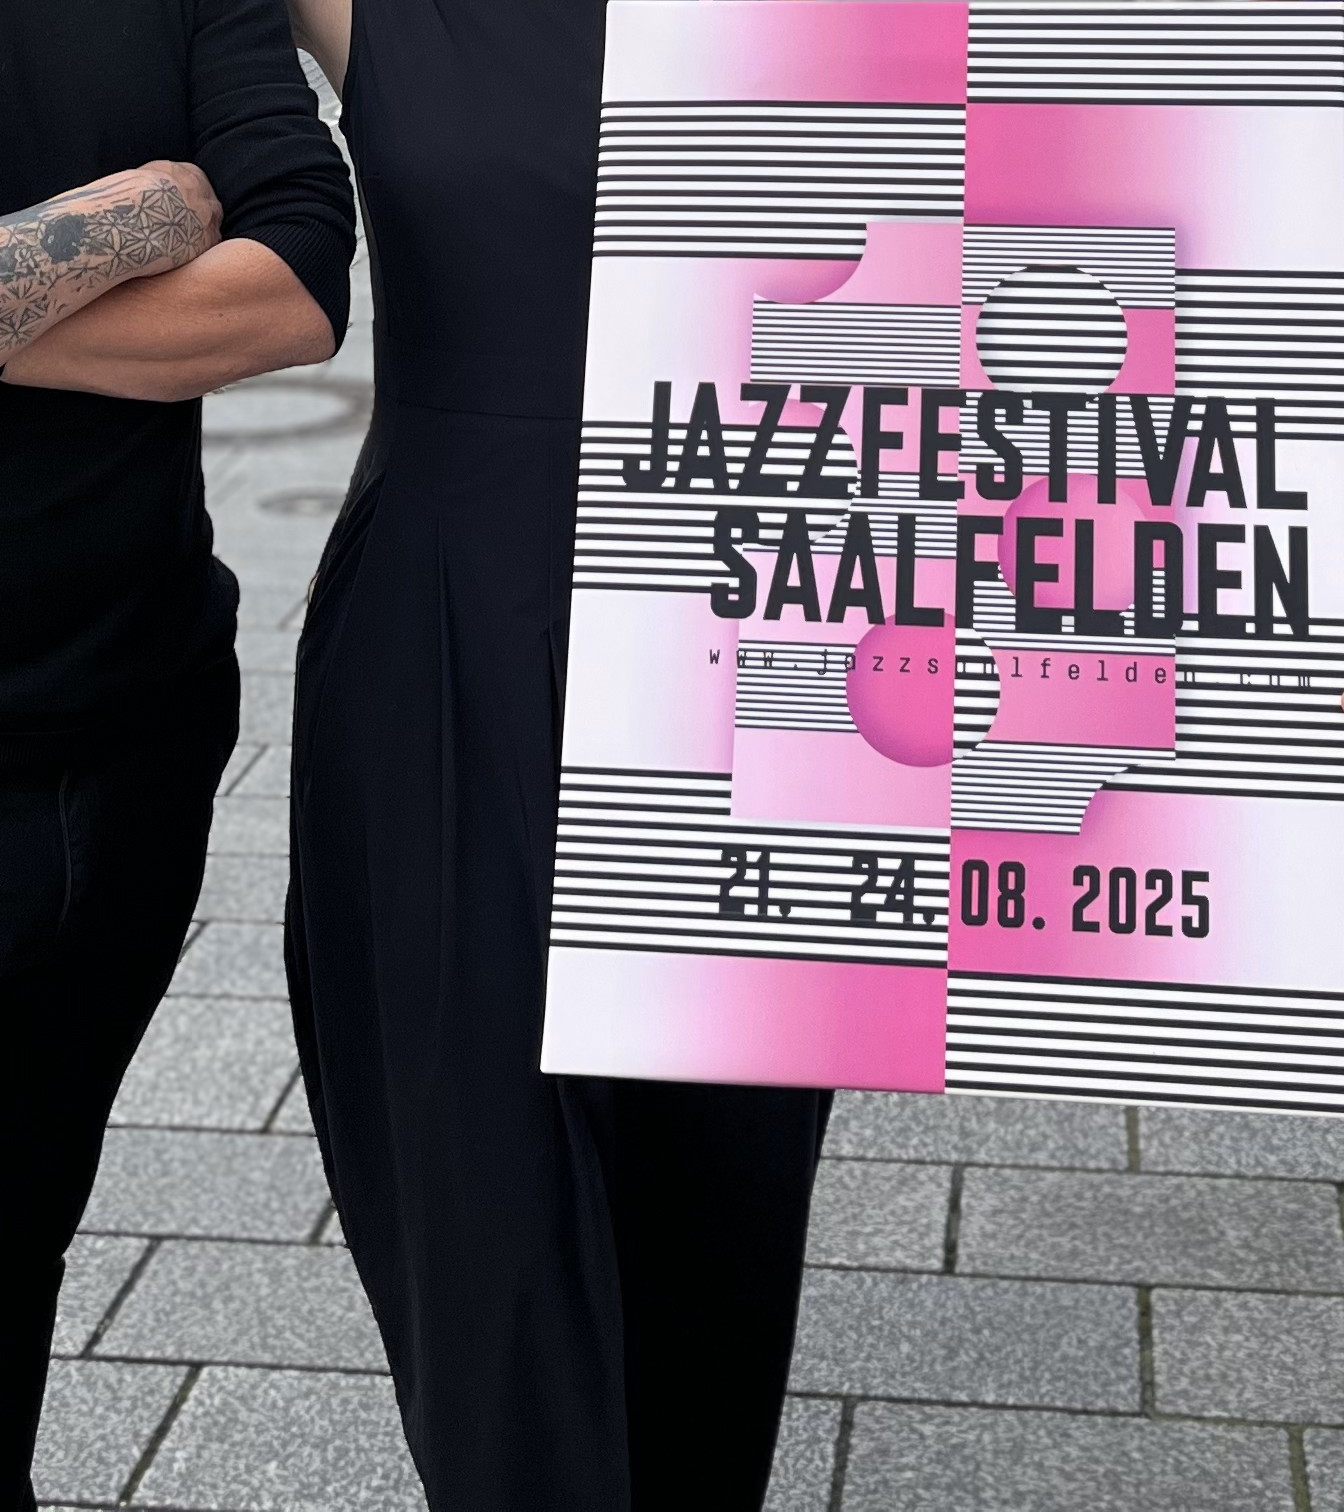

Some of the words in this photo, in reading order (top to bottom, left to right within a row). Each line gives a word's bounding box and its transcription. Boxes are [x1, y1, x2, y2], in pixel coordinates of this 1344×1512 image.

[621, 380, 1309, 511] JAZZFESTIVAL
[709, 508, 1309, 640] SAALFELDEN
[718, 849, 792, 918] 21.
[850, 855, 936, 928] 24.
[960, 858, 1046, 931] 08.
[1071, 863, 1211, 939] 2025
